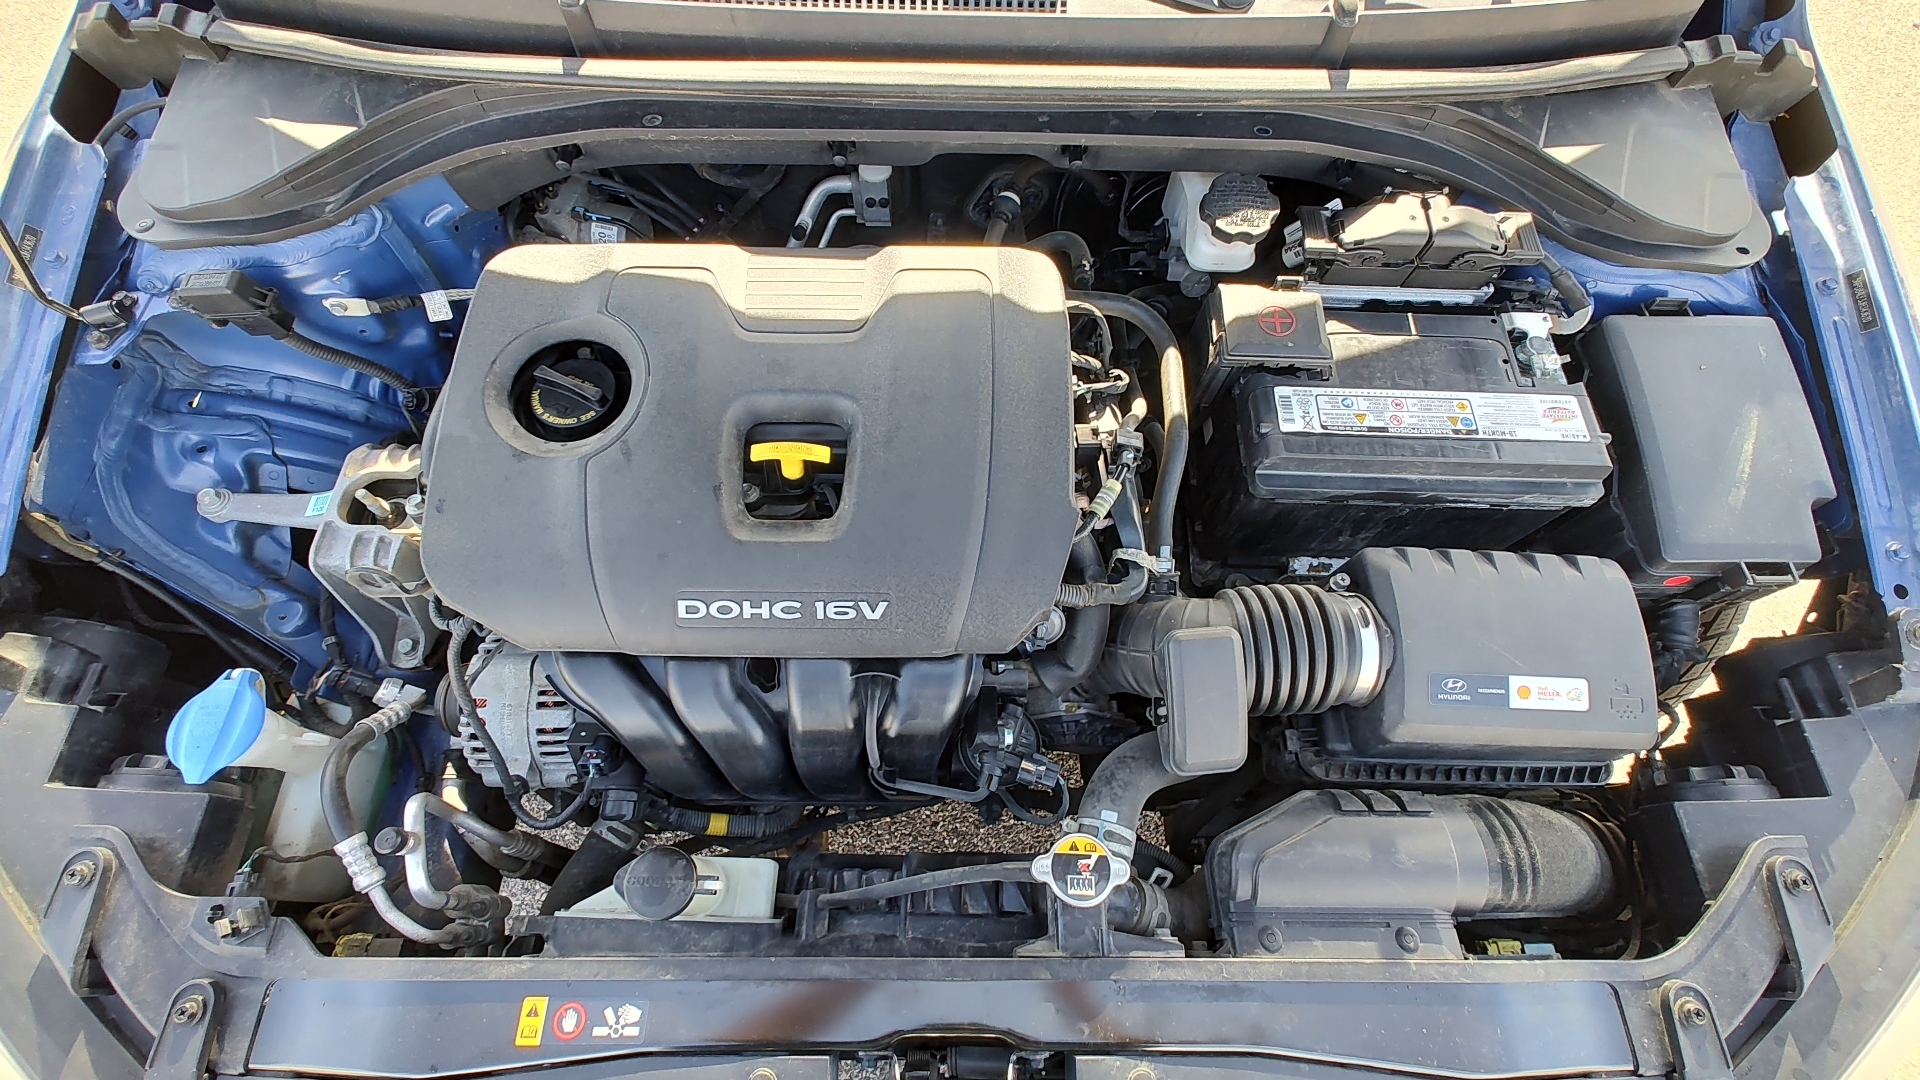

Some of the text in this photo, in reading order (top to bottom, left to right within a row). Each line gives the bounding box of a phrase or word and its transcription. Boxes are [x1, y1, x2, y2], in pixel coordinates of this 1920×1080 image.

[530, 388, 597, 425] SEE OWNER'S MANUAL
[1388, 427, 1453, 435] DANGER/POISON
[1482, 429, 1518, 438] 18-MONTH
[783, 445, 812, 453] ENGINE
[677, 600, 889, 620] DOHC 16V
[1438, 693, 1471, 701] HYUNDAI
[1537, 690, 1561, 698] HELIX
